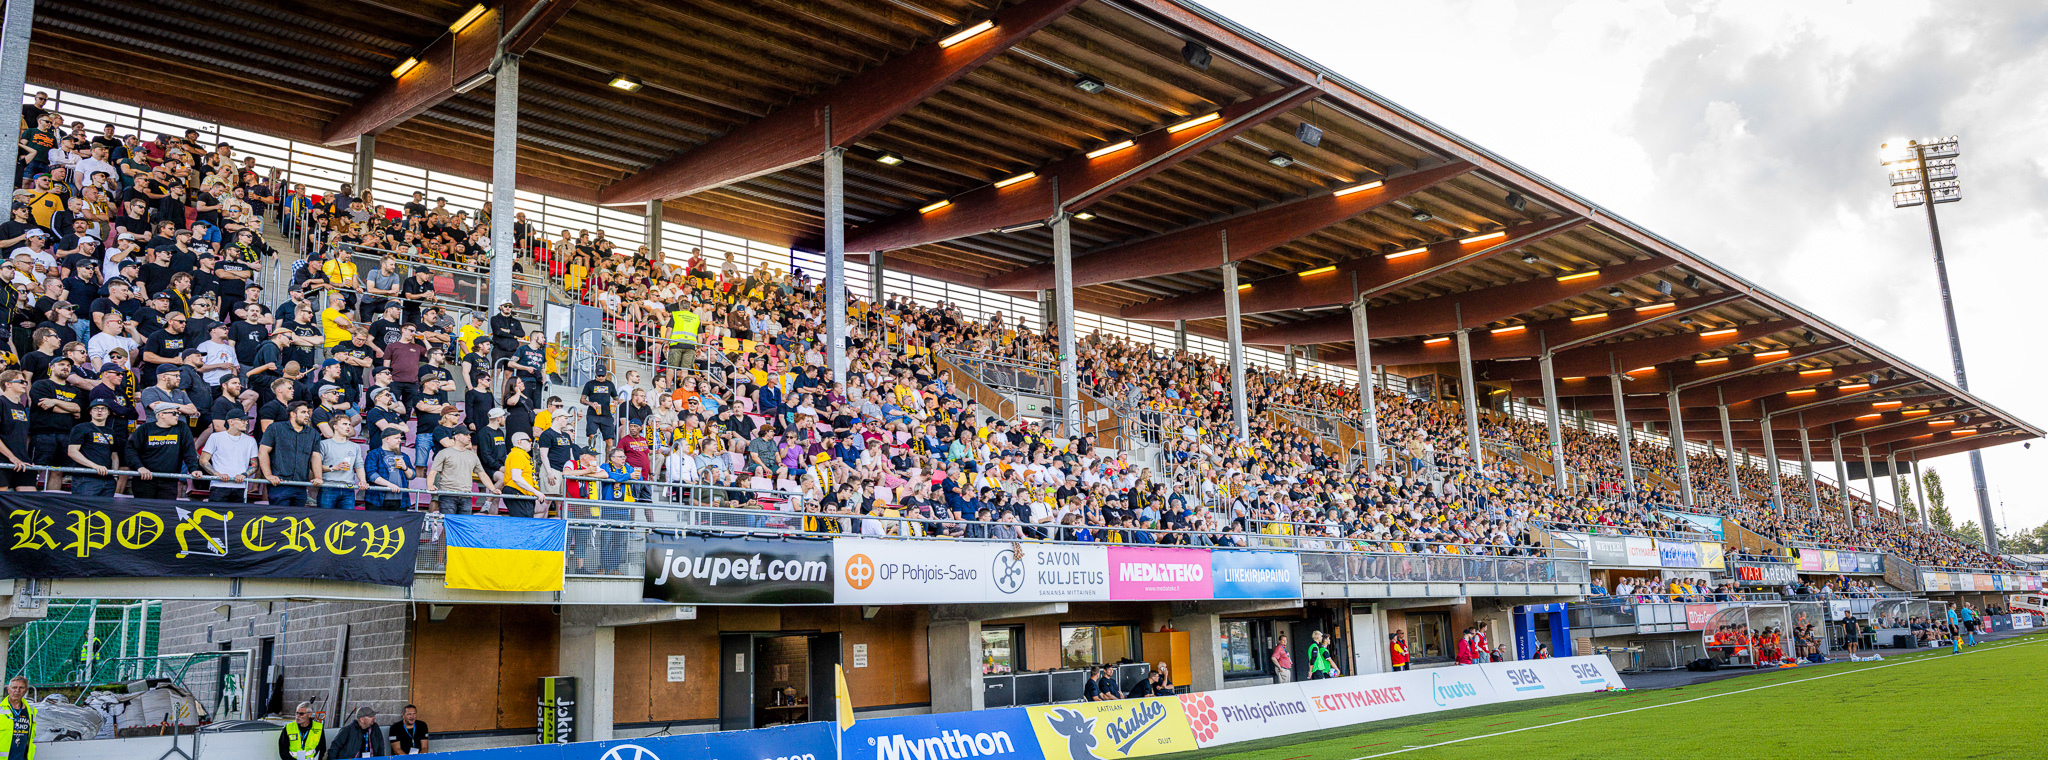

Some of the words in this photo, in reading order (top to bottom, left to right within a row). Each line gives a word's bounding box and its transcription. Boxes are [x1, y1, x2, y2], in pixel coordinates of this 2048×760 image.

[241, 515, 406, 560] CREW
[654, 549, 828, 586] joupet.com
[1037, 551, 1080, 566] SAVON
[880, 563, 899, 580] OP
[902, 564, 978, 584] Pohjois-Savo
[1037, 571, 1104, 585] KULJETUS
[1119, 563, 1204, 582] MEDIATEKO
[1224, 568, 1291, 583] LIIKEKIRJAPAINO
[1764, 567, 1798, 581] AREENA
[1506, 668, 1541, 686] SVEA
[1571, 663, 1602, 679] SVEA
[1437, 681, 1477, 700] ruutu
[1096, 704, 1124, 713] LAITILAN
[1221, 699, 1307, 724] Pihlajalinna
[1105, 700, 1164, 745] Kukko
[876, 729, 1016, 760] Mynthon
[1157, 737, 1173, 745] OLUT
